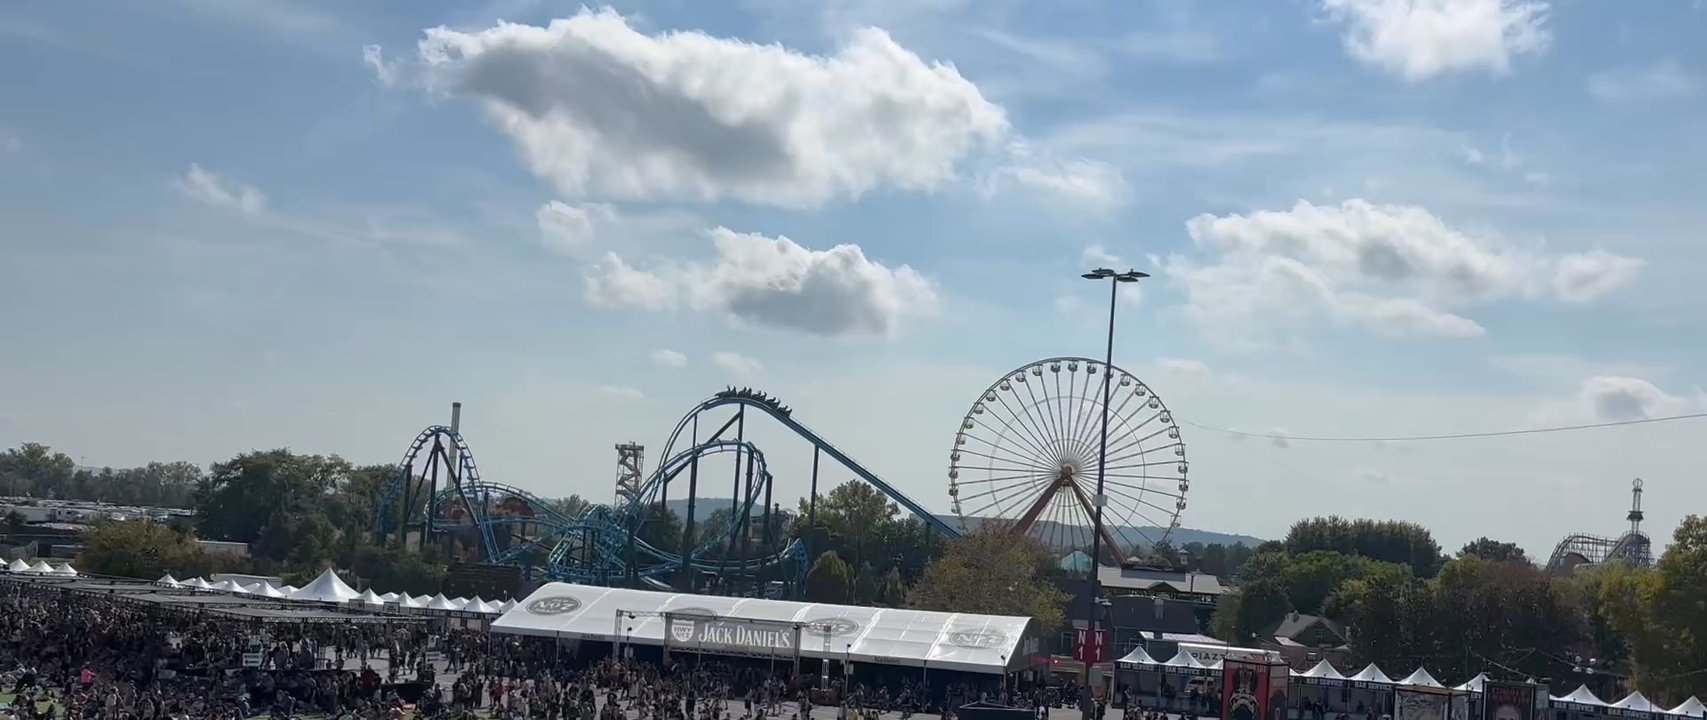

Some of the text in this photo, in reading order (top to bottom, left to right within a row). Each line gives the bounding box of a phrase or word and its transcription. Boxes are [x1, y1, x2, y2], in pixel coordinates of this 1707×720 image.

[698, 621, 733, 644] JACK
[736, 625, 790, 648] DANIEL'S
[1191, 652, 1227, 661] PIAZZ
